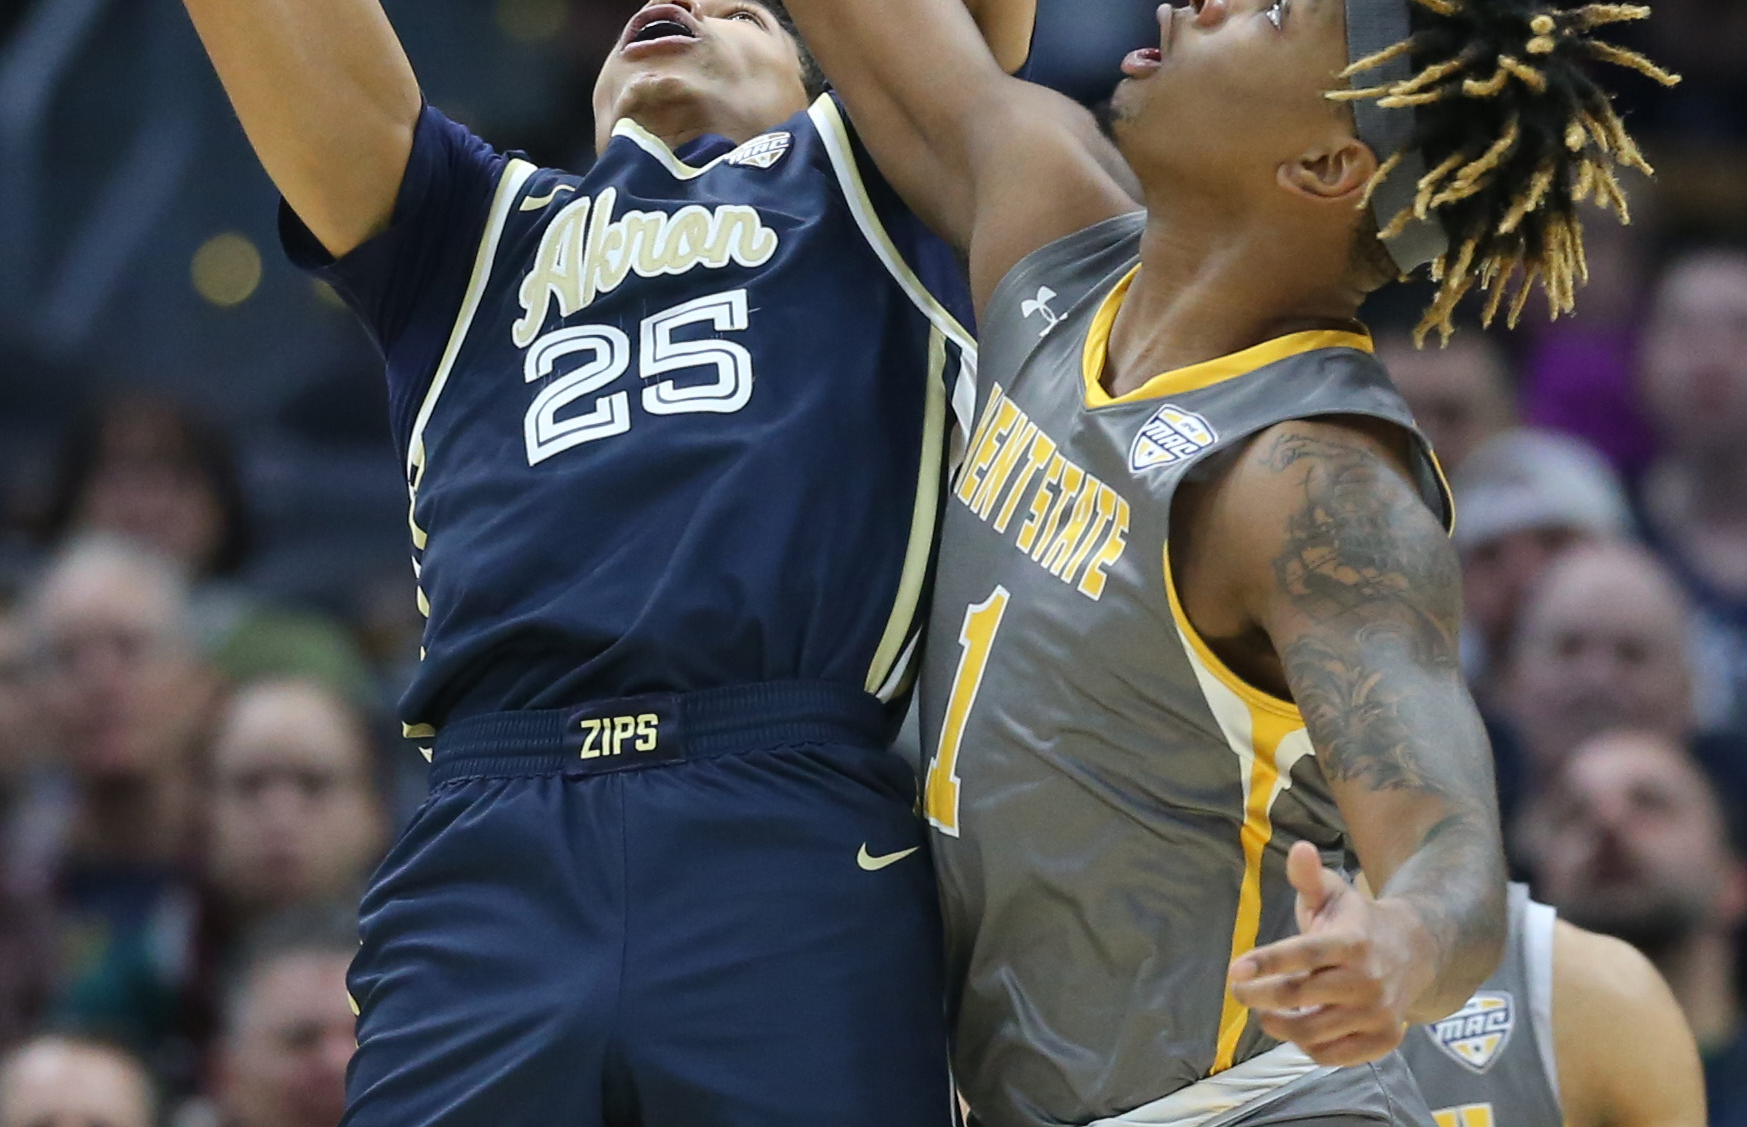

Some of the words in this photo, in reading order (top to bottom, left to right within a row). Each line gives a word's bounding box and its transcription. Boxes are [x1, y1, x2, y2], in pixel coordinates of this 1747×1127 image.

[727, 136, 790, 166] MAC
[512, 187, 779, 348] Akron
[524, 288, 753, 467] 25
[1143, 419, 1202, 459] MAC
[1015, 451, 1131, 602] STATE
[580, 713, 659, 760] ZIPS
[924, 584, 1011, 838] 1
[1435, 1010, 1510, 1043] MAC
